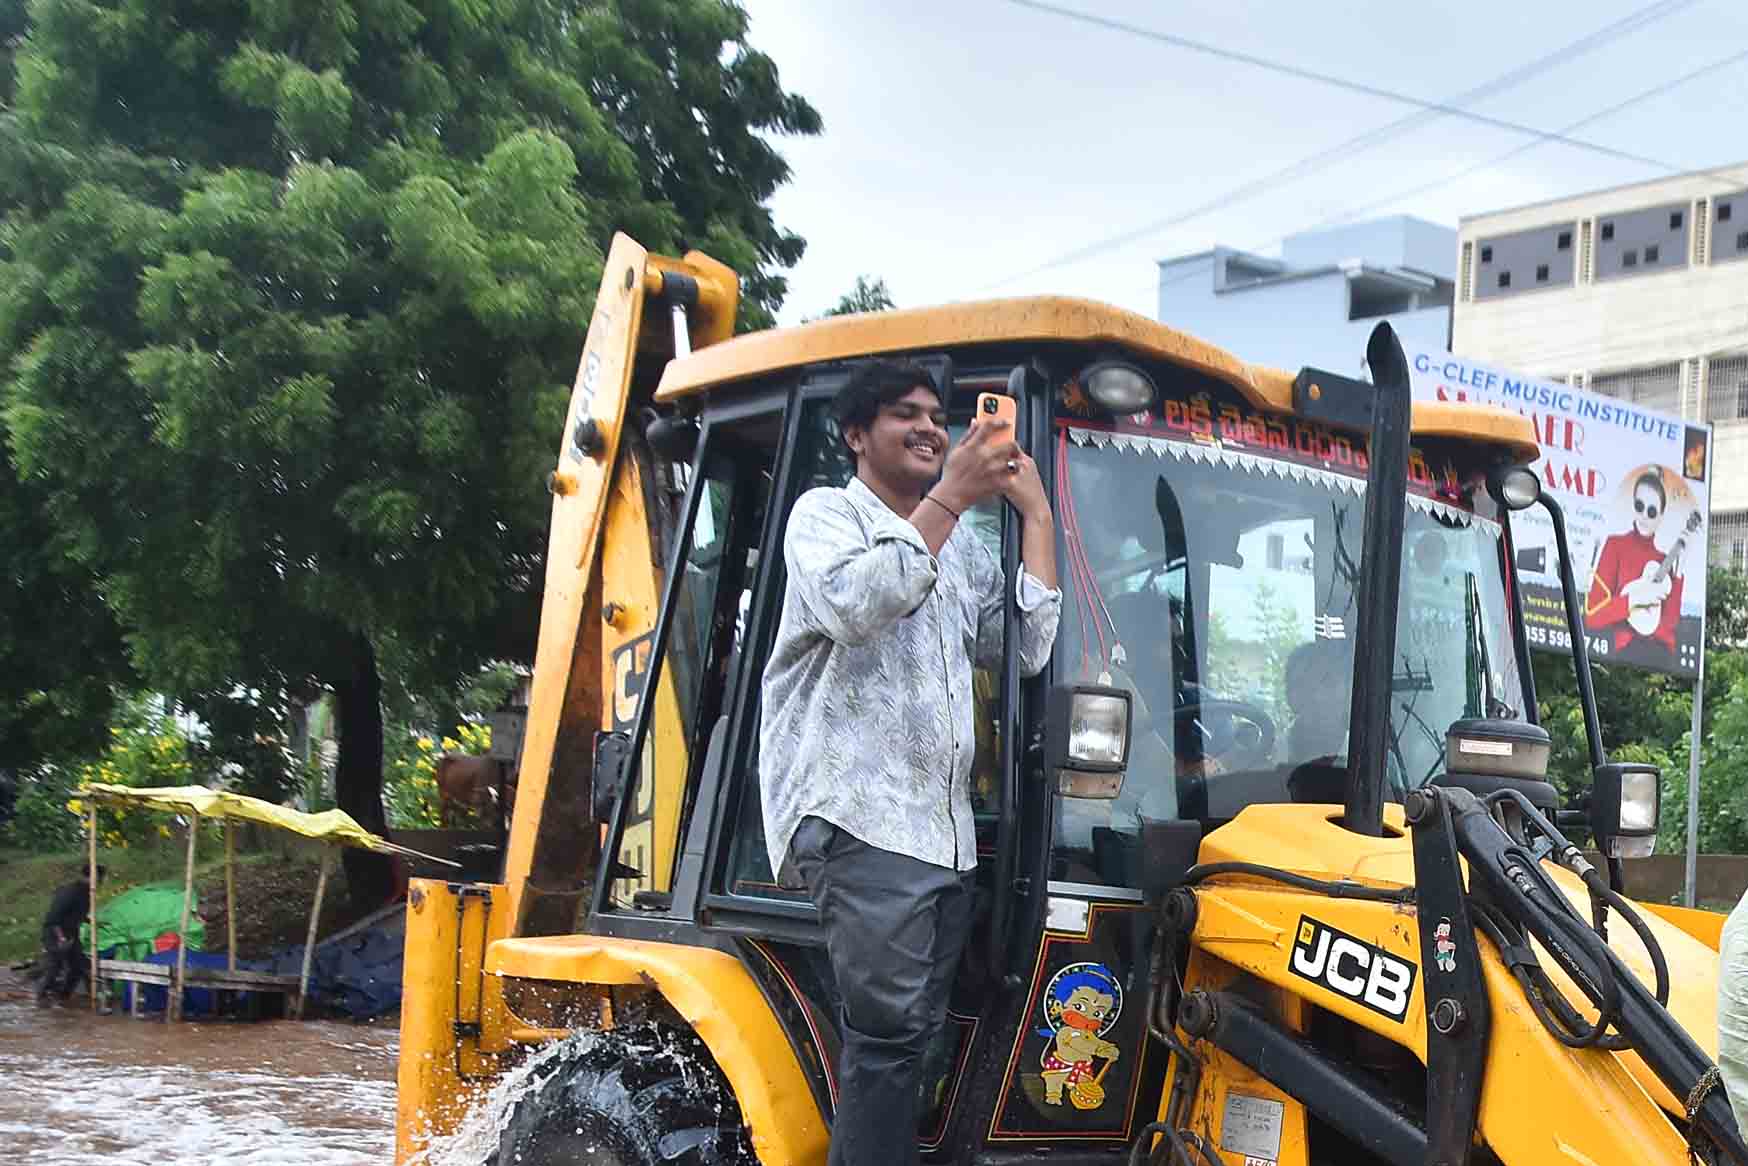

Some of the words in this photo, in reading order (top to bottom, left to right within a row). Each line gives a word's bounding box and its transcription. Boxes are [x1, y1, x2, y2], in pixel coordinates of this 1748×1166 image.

[1415, 354, 1497, 390] G-CLEF
[1503, 378, 1574, 411] MUSIC
[1577, 399, 1680, 441] INSTITUTE
[1544, 458, 1607, 497] AMP
[1295, 928, 1412, 1016] JCB
